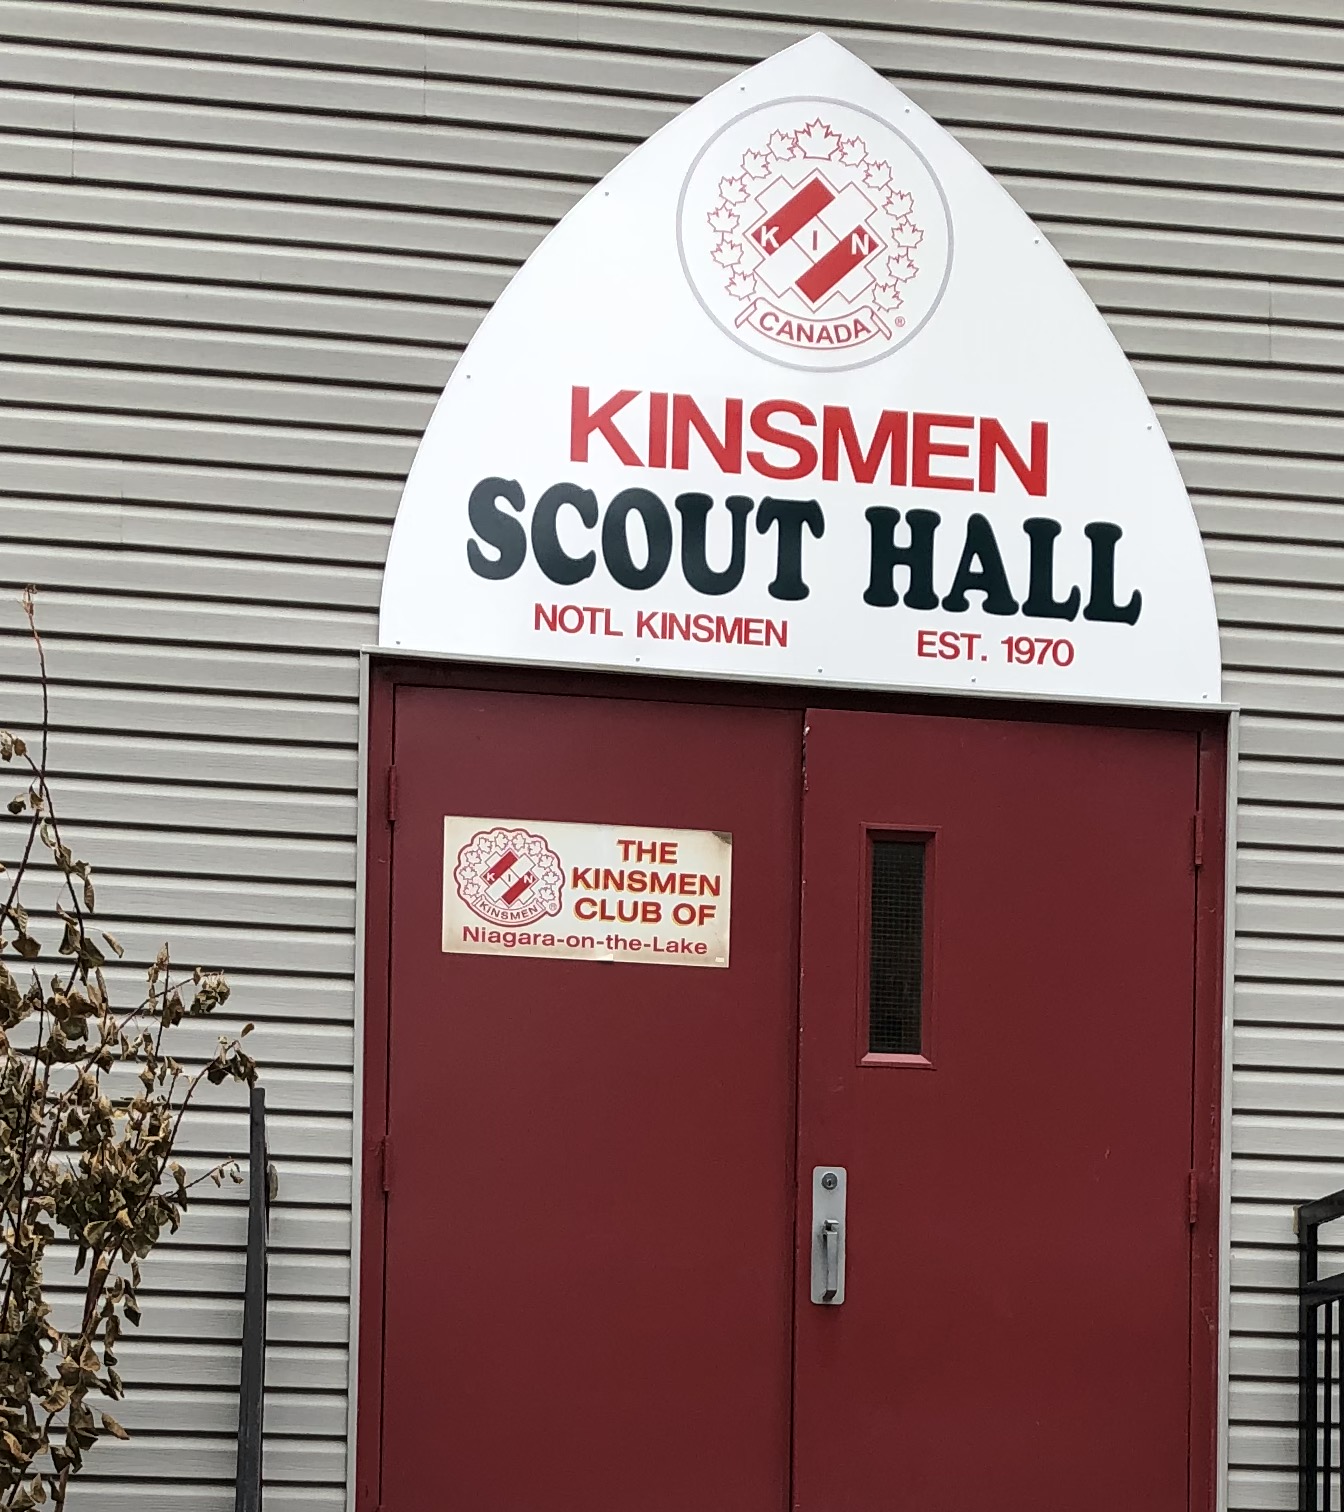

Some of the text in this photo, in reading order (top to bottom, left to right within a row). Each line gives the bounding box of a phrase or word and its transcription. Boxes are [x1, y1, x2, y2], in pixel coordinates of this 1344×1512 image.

[759, 311, 872, 345] CANADA
[570, 386, 1049, 498] KINSMEN
[467, 477, 1142, 627] SCOUT HALL
[535, 604, 1075, 668] NOTL KINSMEN EST. 1970
[617, 839, 678, 865] THE
[572, 867, 721, 897] KINSMEN
[480, 900, 538, 920] KINSMEN
[574, 897, 717, 926] CLUB OF
[462, 926, 708, 955] Niagara-on-the-Lake
